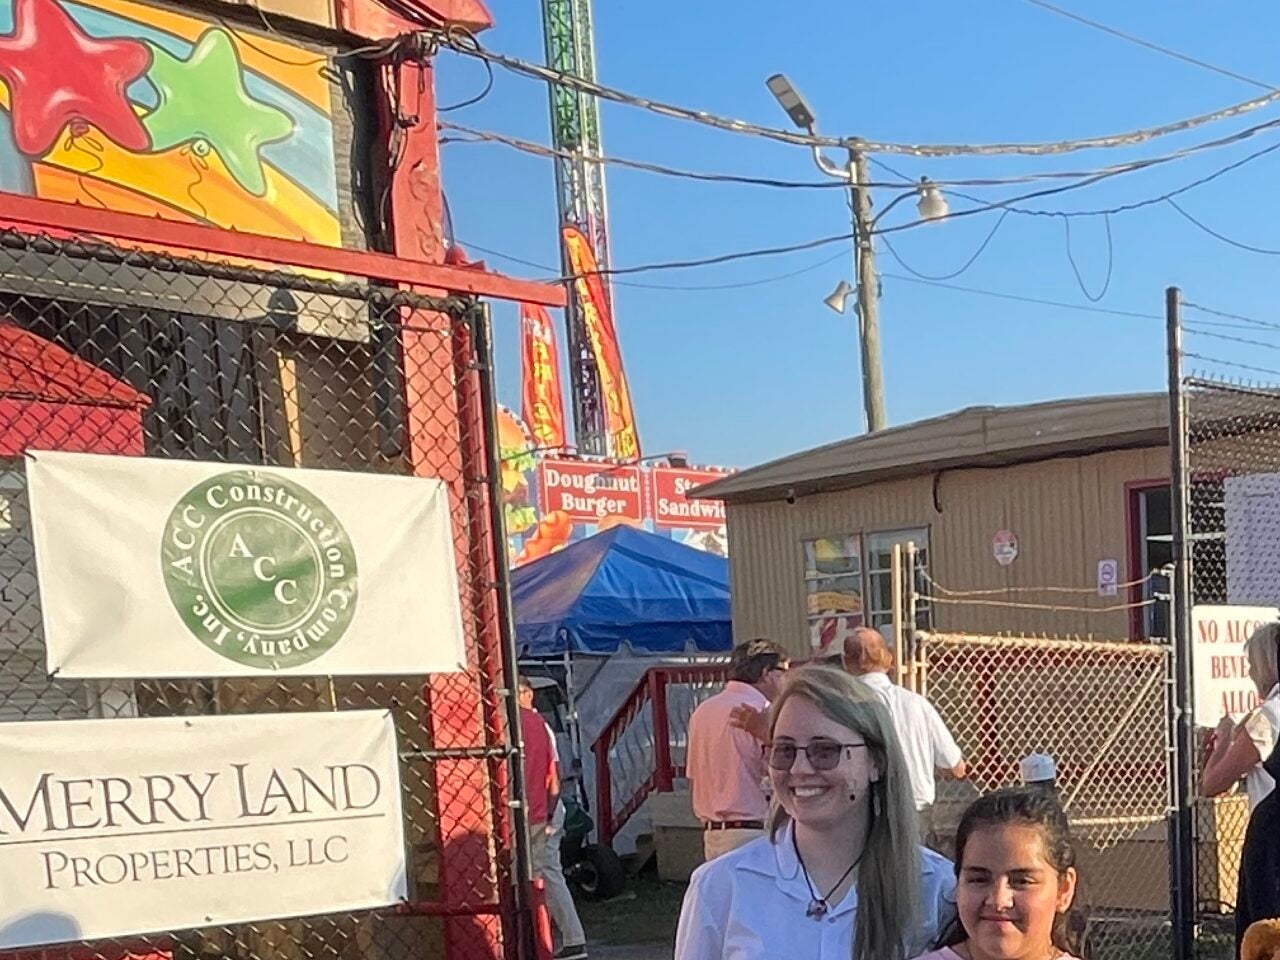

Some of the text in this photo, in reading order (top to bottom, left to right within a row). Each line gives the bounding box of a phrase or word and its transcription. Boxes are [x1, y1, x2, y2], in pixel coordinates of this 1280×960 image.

[561, 492, 627, 517] Burger
[170, 484, 345, 578] ACC Construction
[193, 589, 348, 656] Company, Inc.
[1198, 619, 1218, 643] NO
[1211, 655, 1249, 679] BEVE
[1220, 691, 1257, 713] ALLO
[0, 763, 381, 834] MERRY LAND
[40, 835, 349, 889] PROPERTIES, LLC
